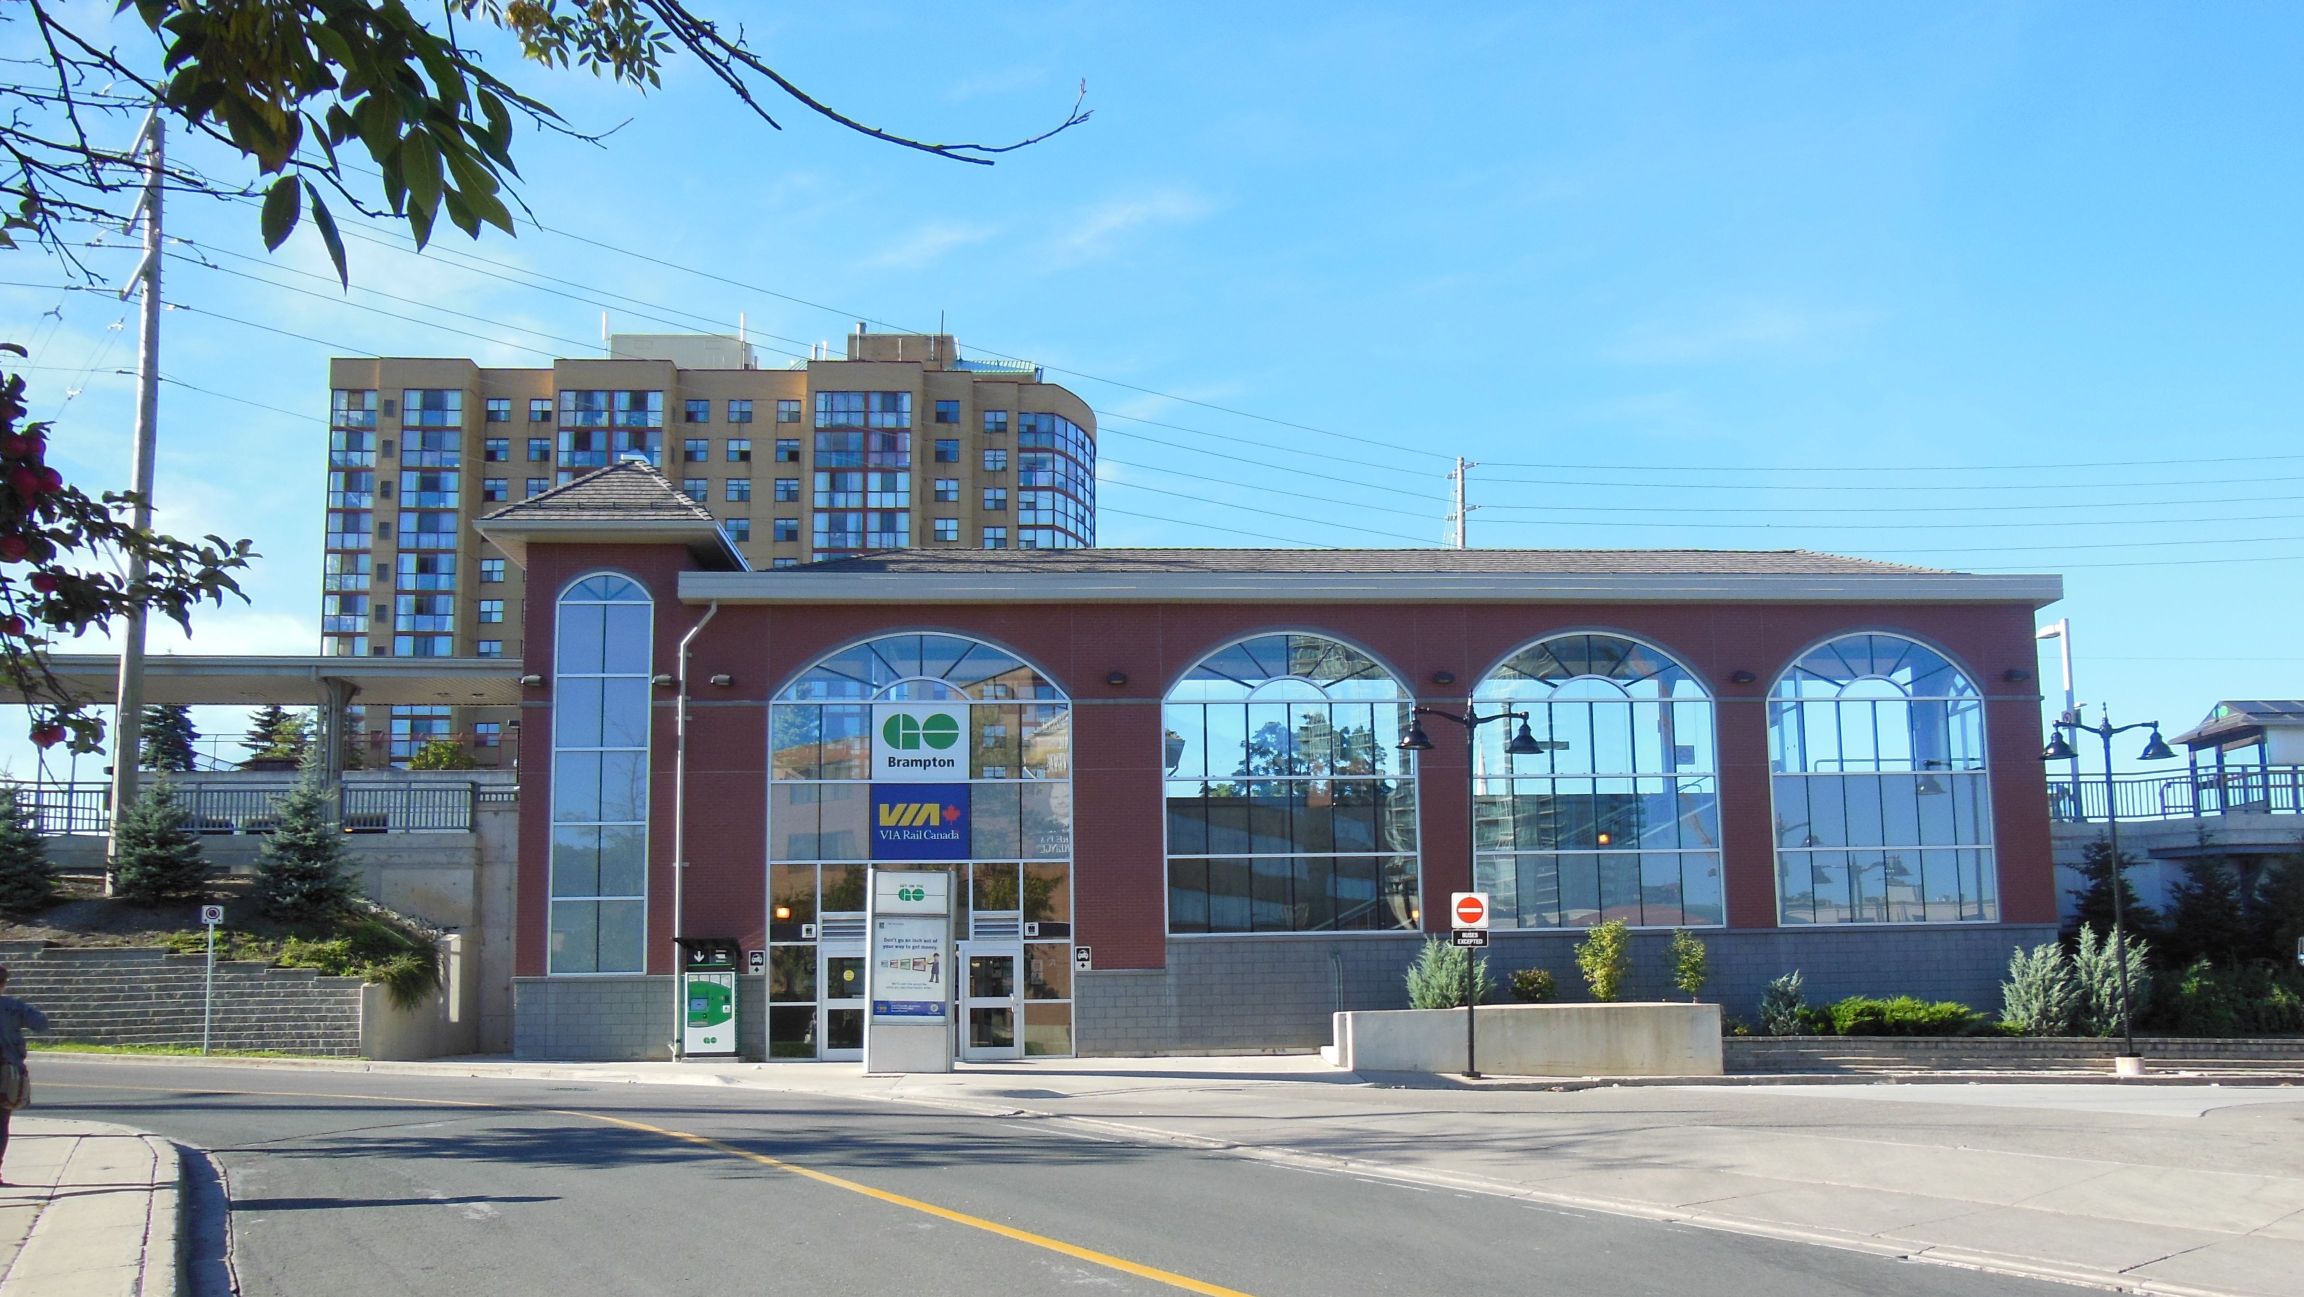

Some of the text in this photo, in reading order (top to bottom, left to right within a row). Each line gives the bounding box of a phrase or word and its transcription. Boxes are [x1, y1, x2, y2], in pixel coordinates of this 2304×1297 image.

[883, 713, 959, 750] GO
[888, 756, 955, 770] Brampton
[880, 803, 940, 826] VIA
[880, 829, 959, 840] VIA Rail Canada
[898, 888, 925, 901] GO
